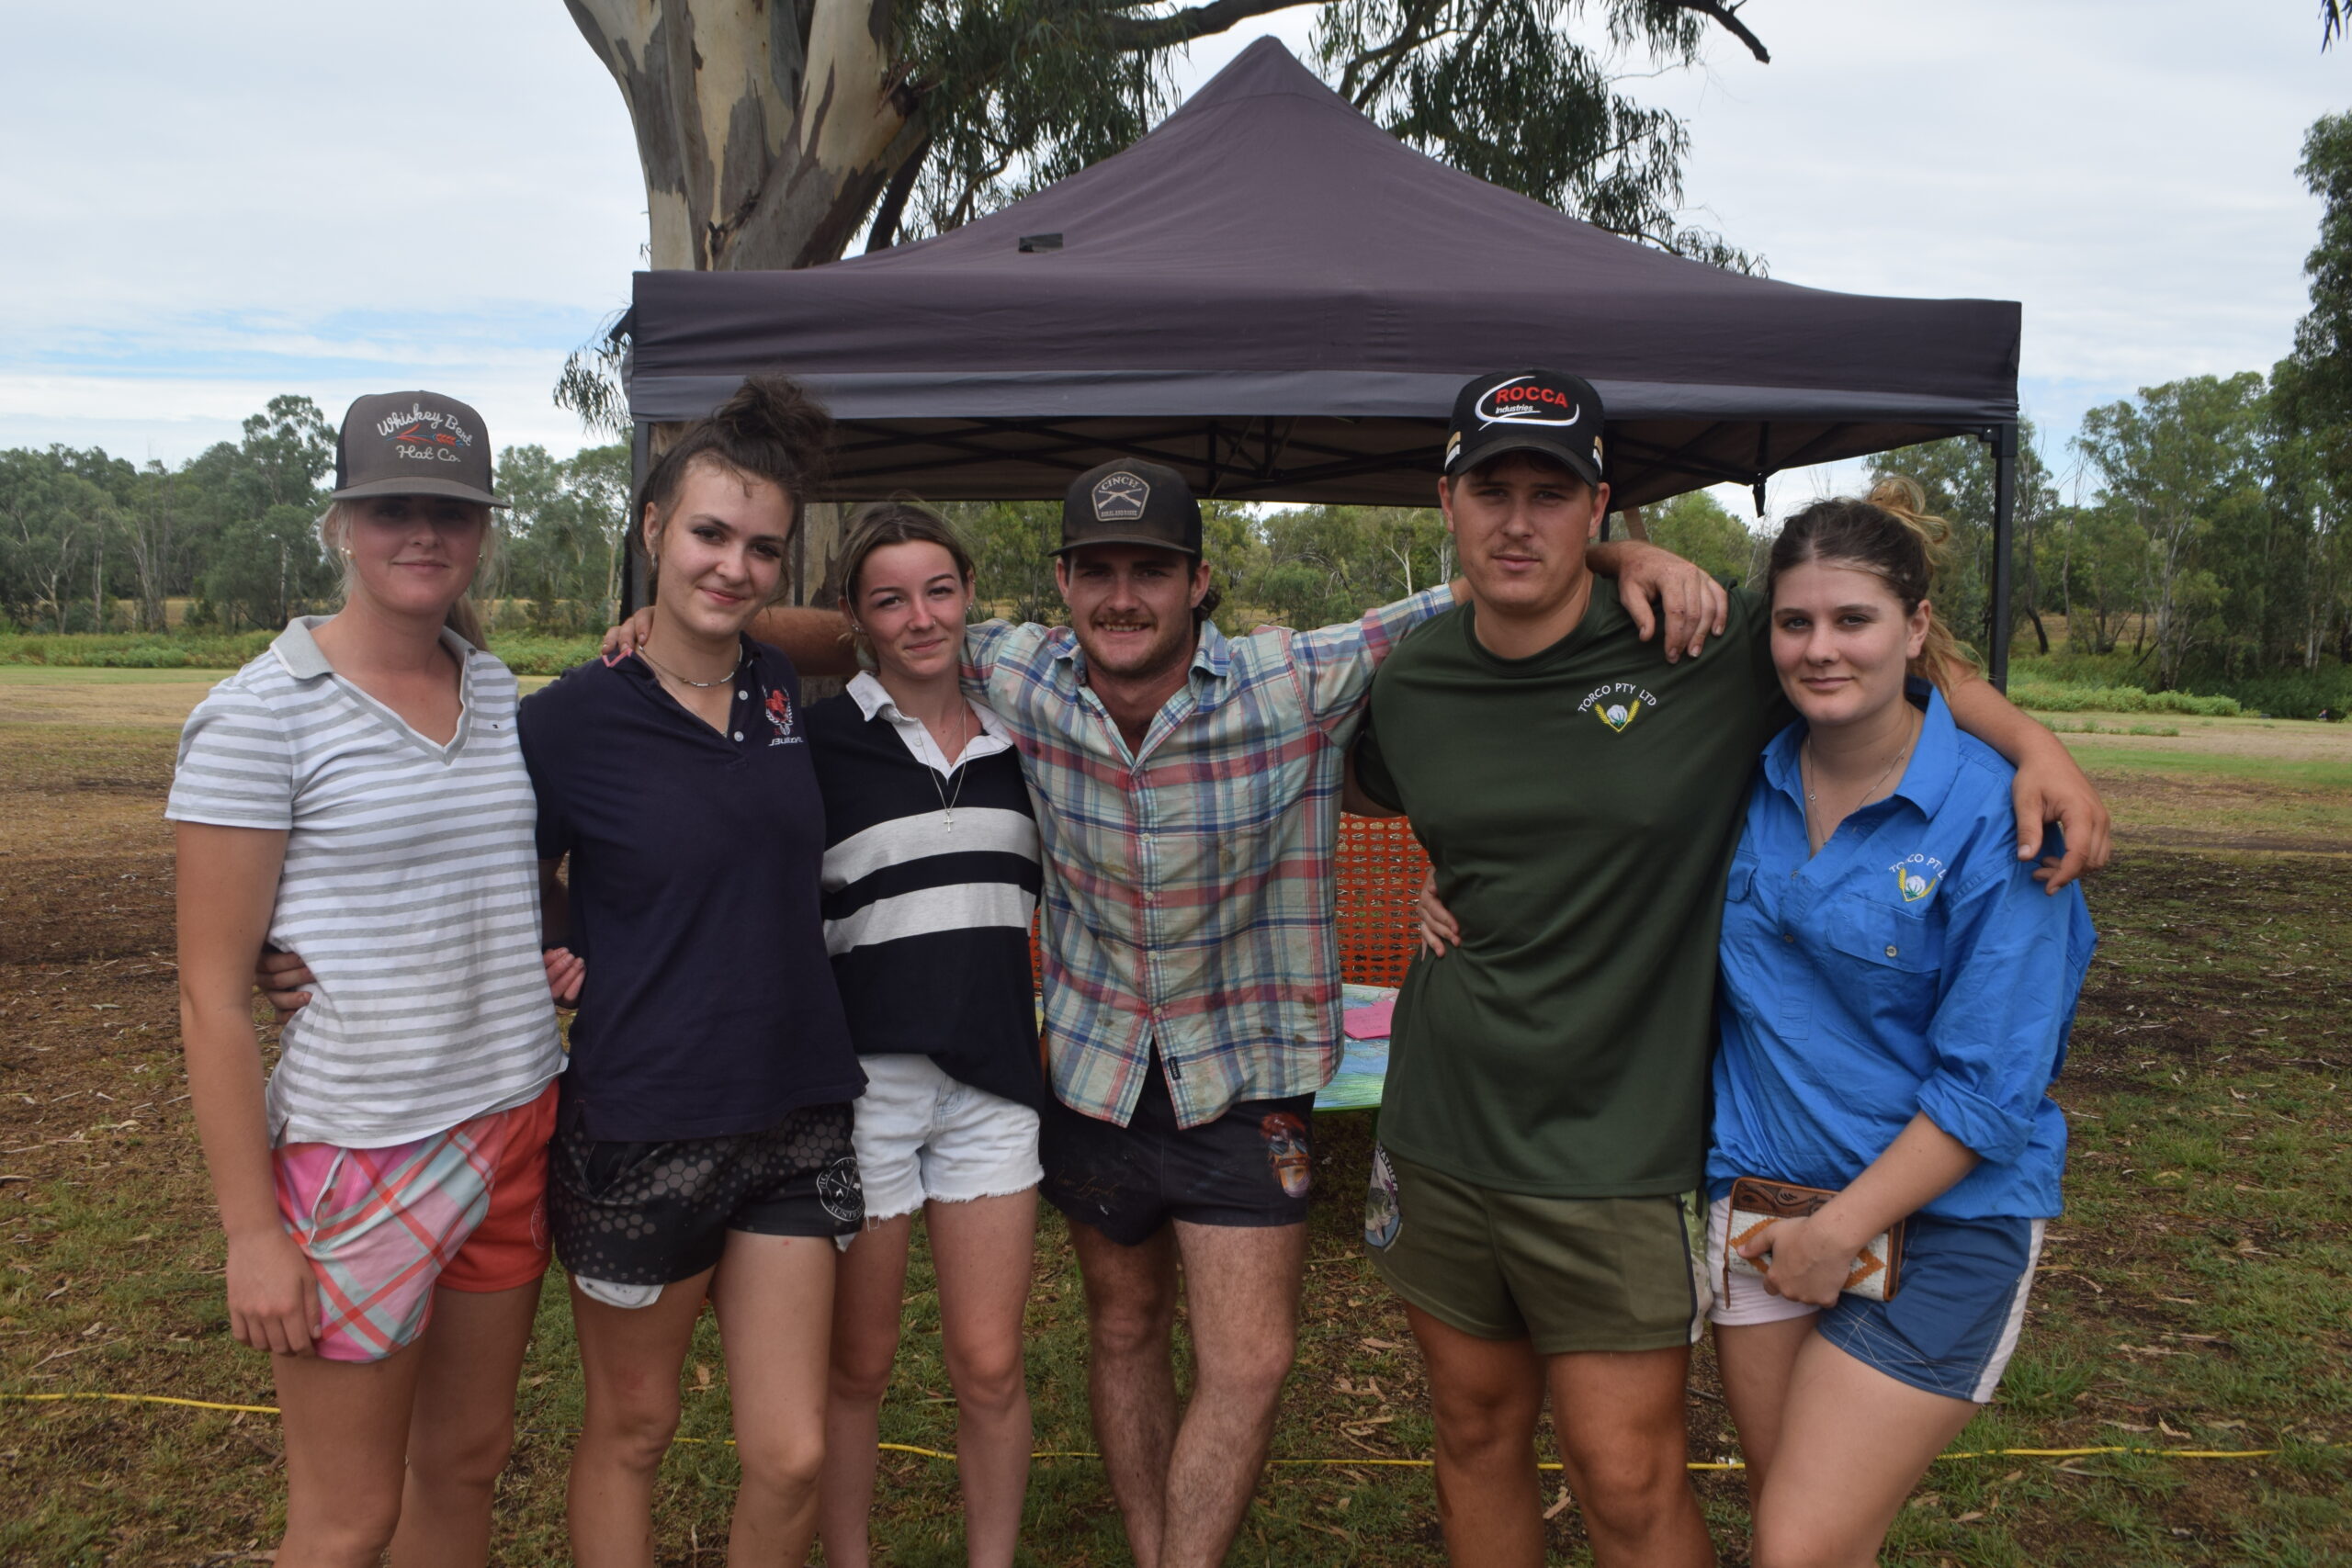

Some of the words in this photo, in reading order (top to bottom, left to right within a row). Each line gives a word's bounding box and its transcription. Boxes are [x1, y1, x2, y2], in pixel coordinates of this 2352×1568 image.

[1495, 387, 1569, 409] ROCCA
[1495, 403, 1533, 414] Industries
[377, 402, 443, 437] Whiskey
[444, 413, 473, 446] Bent
[395, 444, 435, 459] Hat
[436, 447, 461, 462] Co.
[1101, 476, 1141, 491] CINCH
[1577, 685, 1611, 713] TORCO
[1615, 682, 1636, 694] PTY
[1639, 689, 1657, 706] LTD
[1889, 853, 1924, 873] TOCO
[1927, 857, 1942, 872] PT
